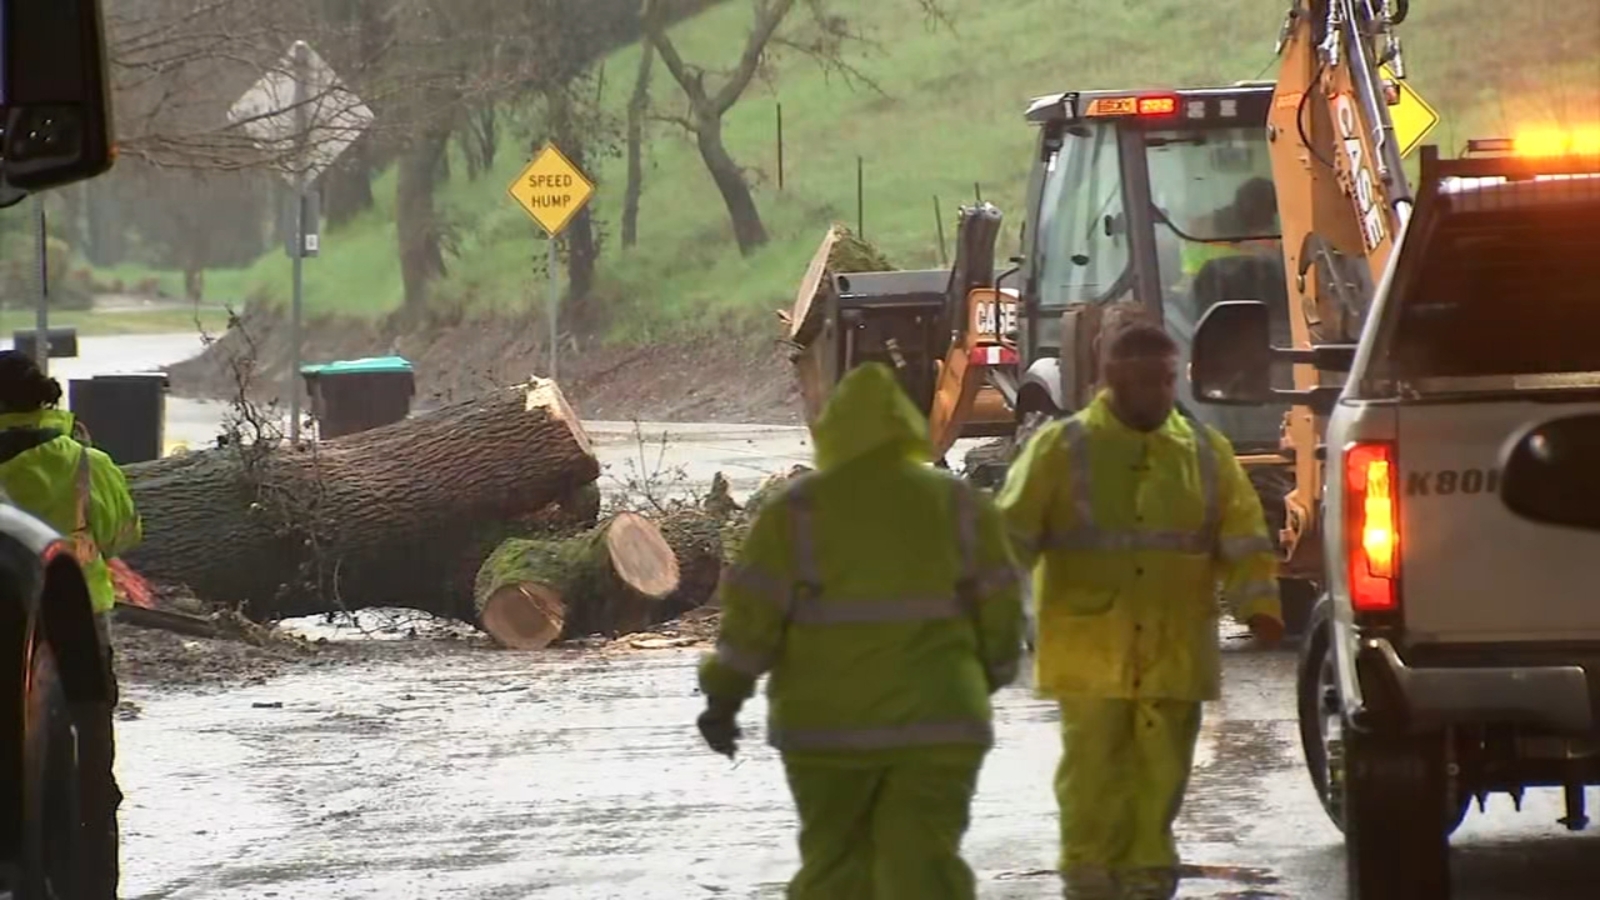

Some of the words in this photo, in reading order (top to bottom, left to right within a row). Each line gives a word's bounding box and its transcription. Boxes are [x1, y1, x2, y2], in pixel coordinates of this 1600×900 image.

[529, 174, 573, 188] SPEED
[1338, 94, 1384, 250] CASE
[532, 194, 571, 208] HUMP
[975, 302, 1017, 334] CASE
